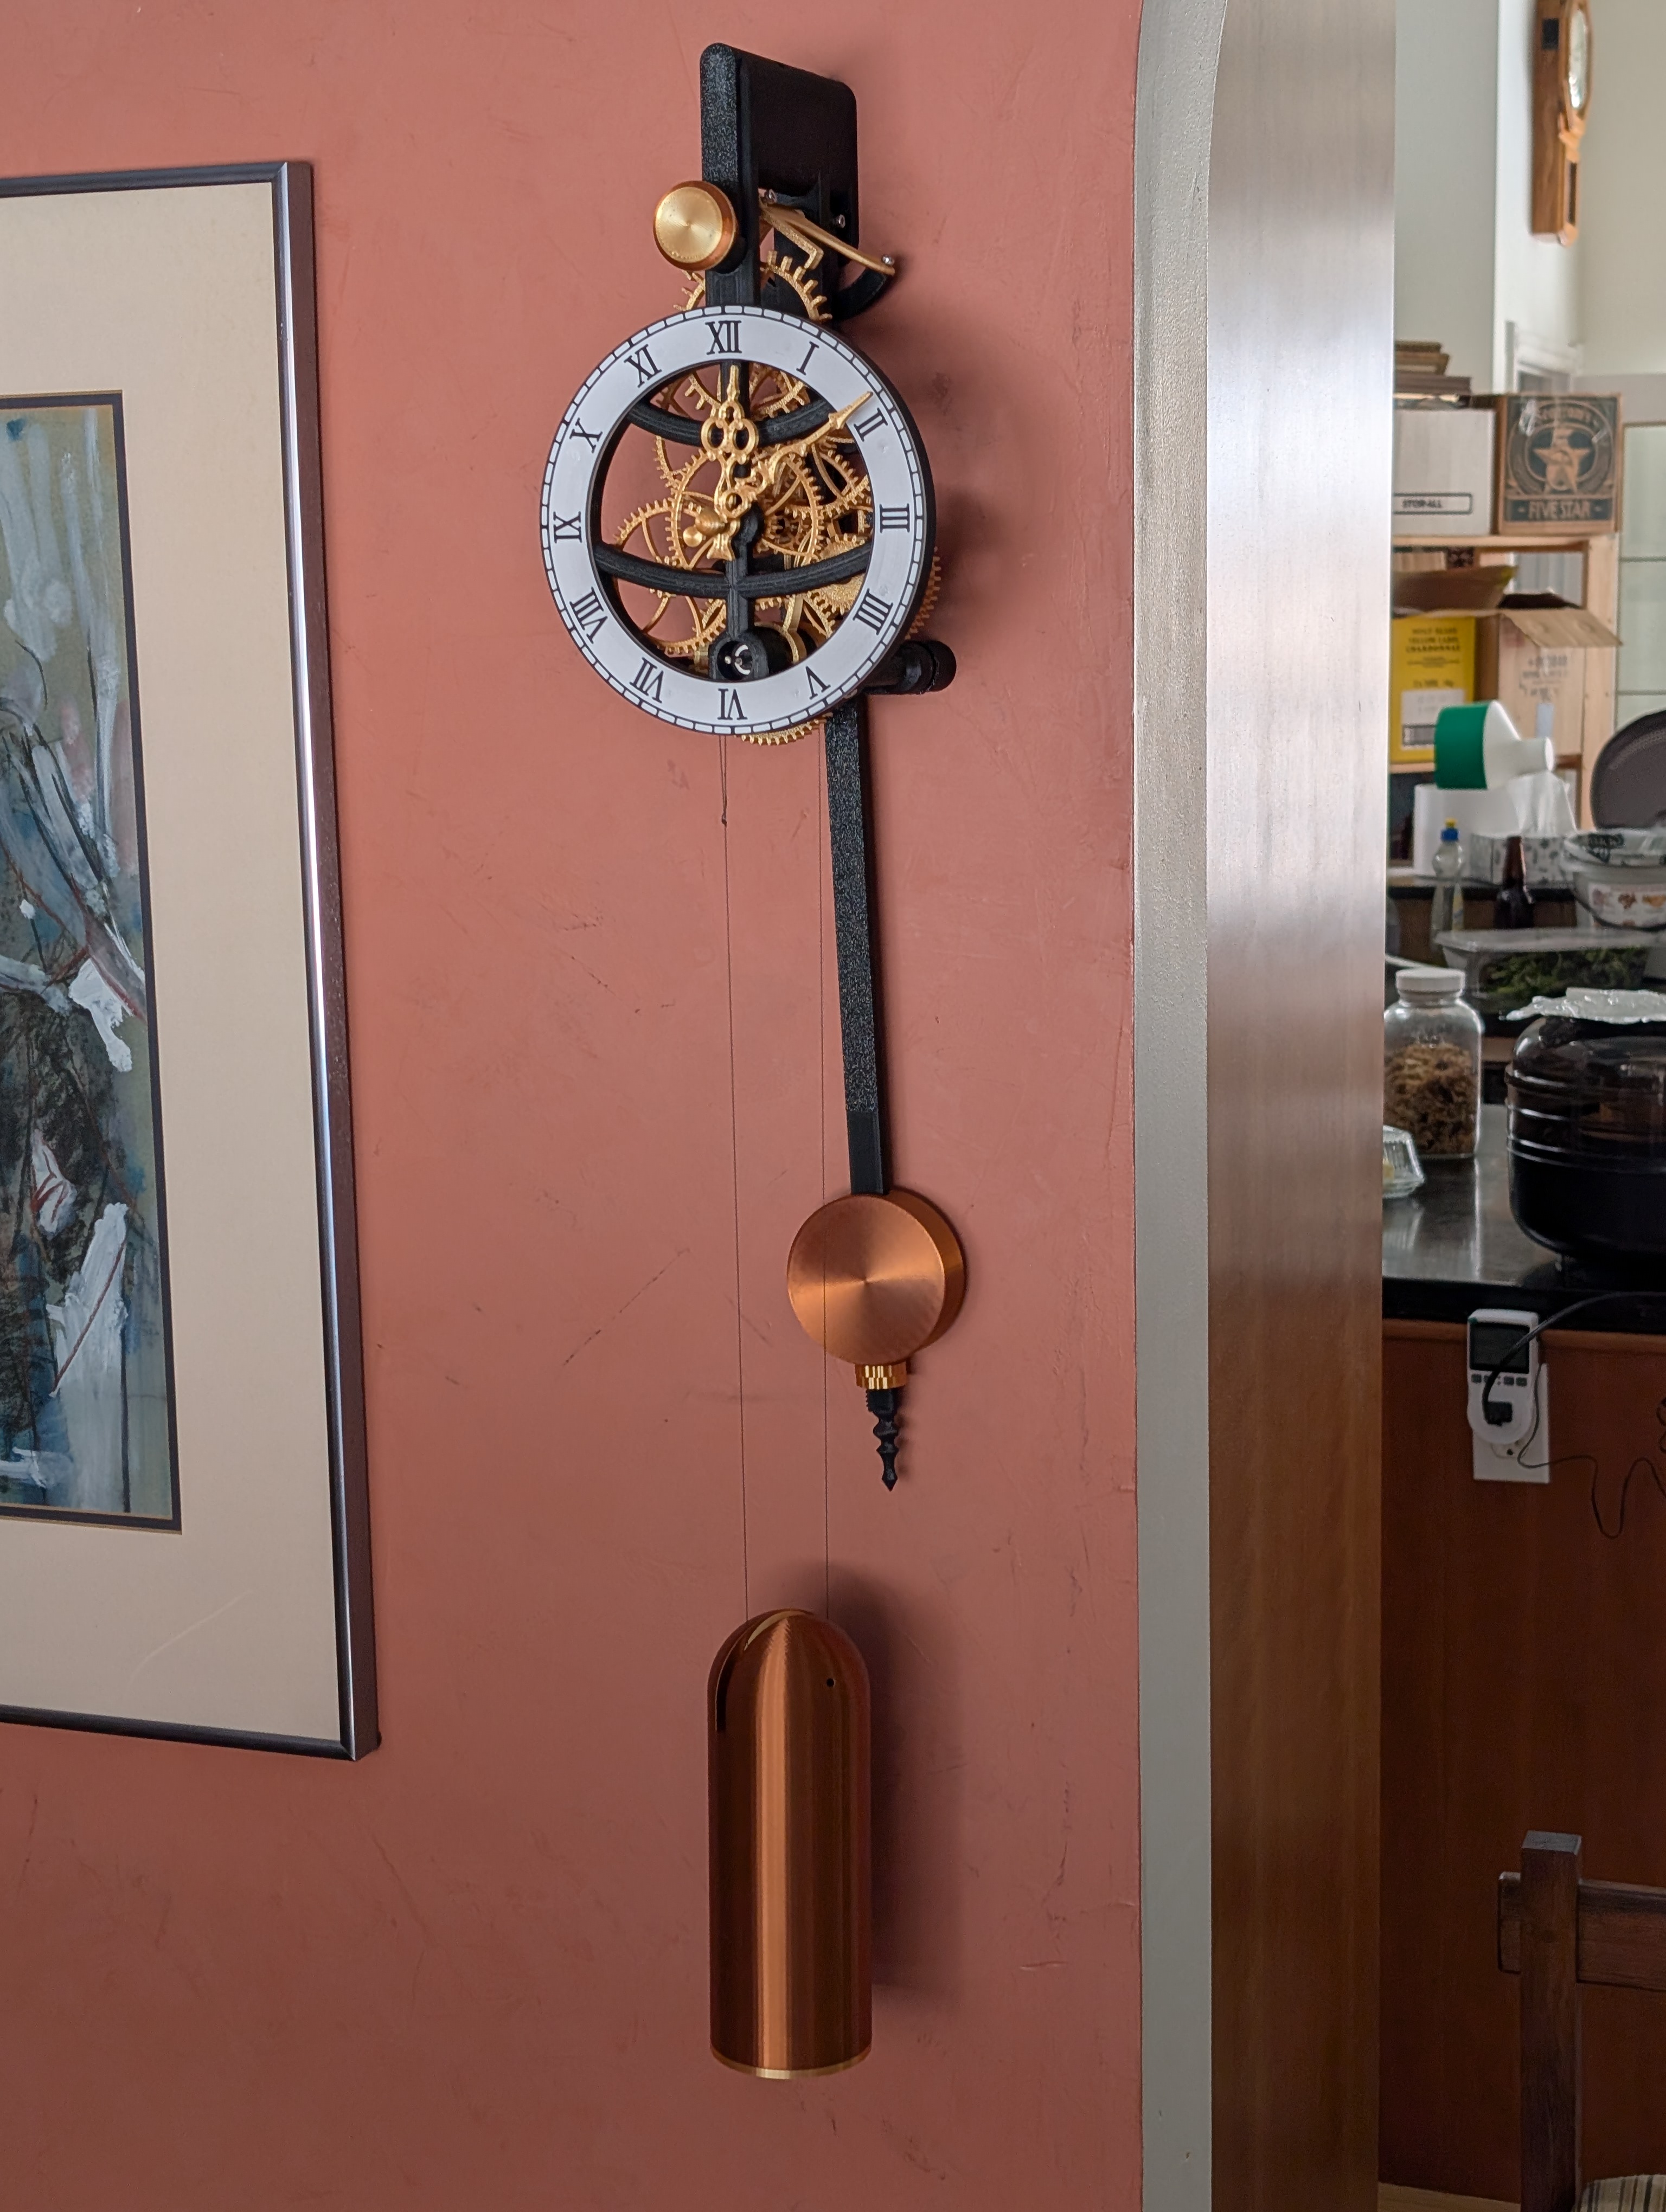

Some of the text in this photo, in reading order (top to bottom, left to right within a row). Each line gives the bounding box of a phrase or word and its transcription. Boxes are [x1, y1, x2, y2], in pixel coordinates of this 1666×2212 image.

[705, 320, 742, 355] XII
[624, 344, 662, 388] XI
[796, 342, 819, 375] I
[569, 418, 603, 453] X
[854, 408, 888, 441] II
[880, 504, 909, 533] III
[1529, 500, 1590, 519] FIVE STAR
[554, 512, 582, 543] IX
[570, 587, 607, 644] VIII
[853, 589, 893, 635] IIII
[630, 658, 663, 703] VII
[806, 666, 830, 699] V
[718, 689, 747, 720] VI
